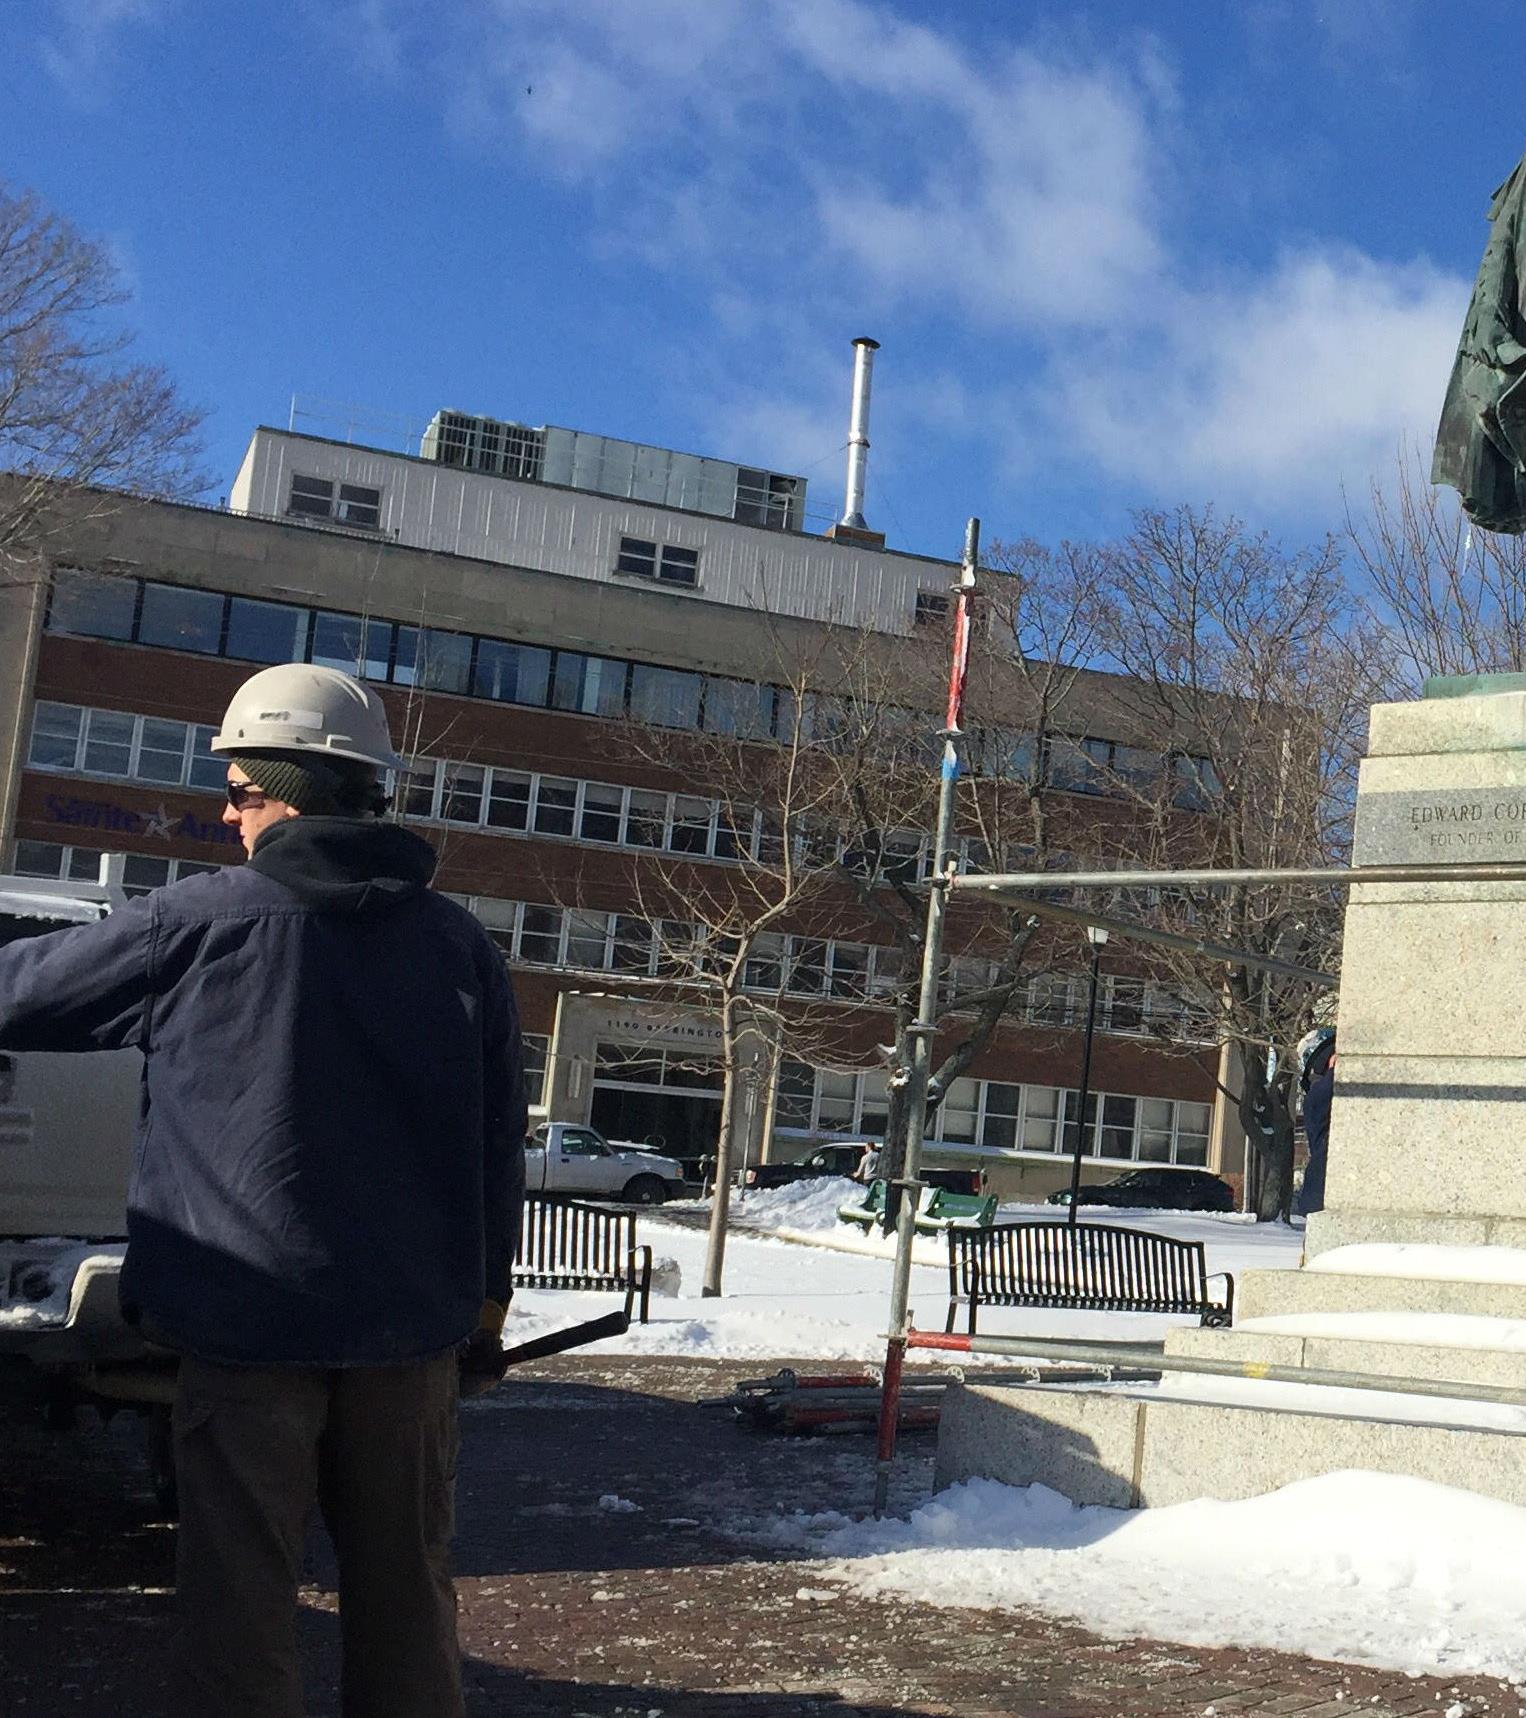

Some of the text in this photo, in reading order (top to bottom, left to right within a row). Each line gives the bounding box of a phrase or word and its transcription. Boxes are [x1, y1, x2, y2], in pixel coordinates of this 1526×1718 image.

[1411, 804, 1483, 824] EDWARD
[1430, 831, 1494, 847] FOUNDER
[1503, 830, 1520, 845] OF
